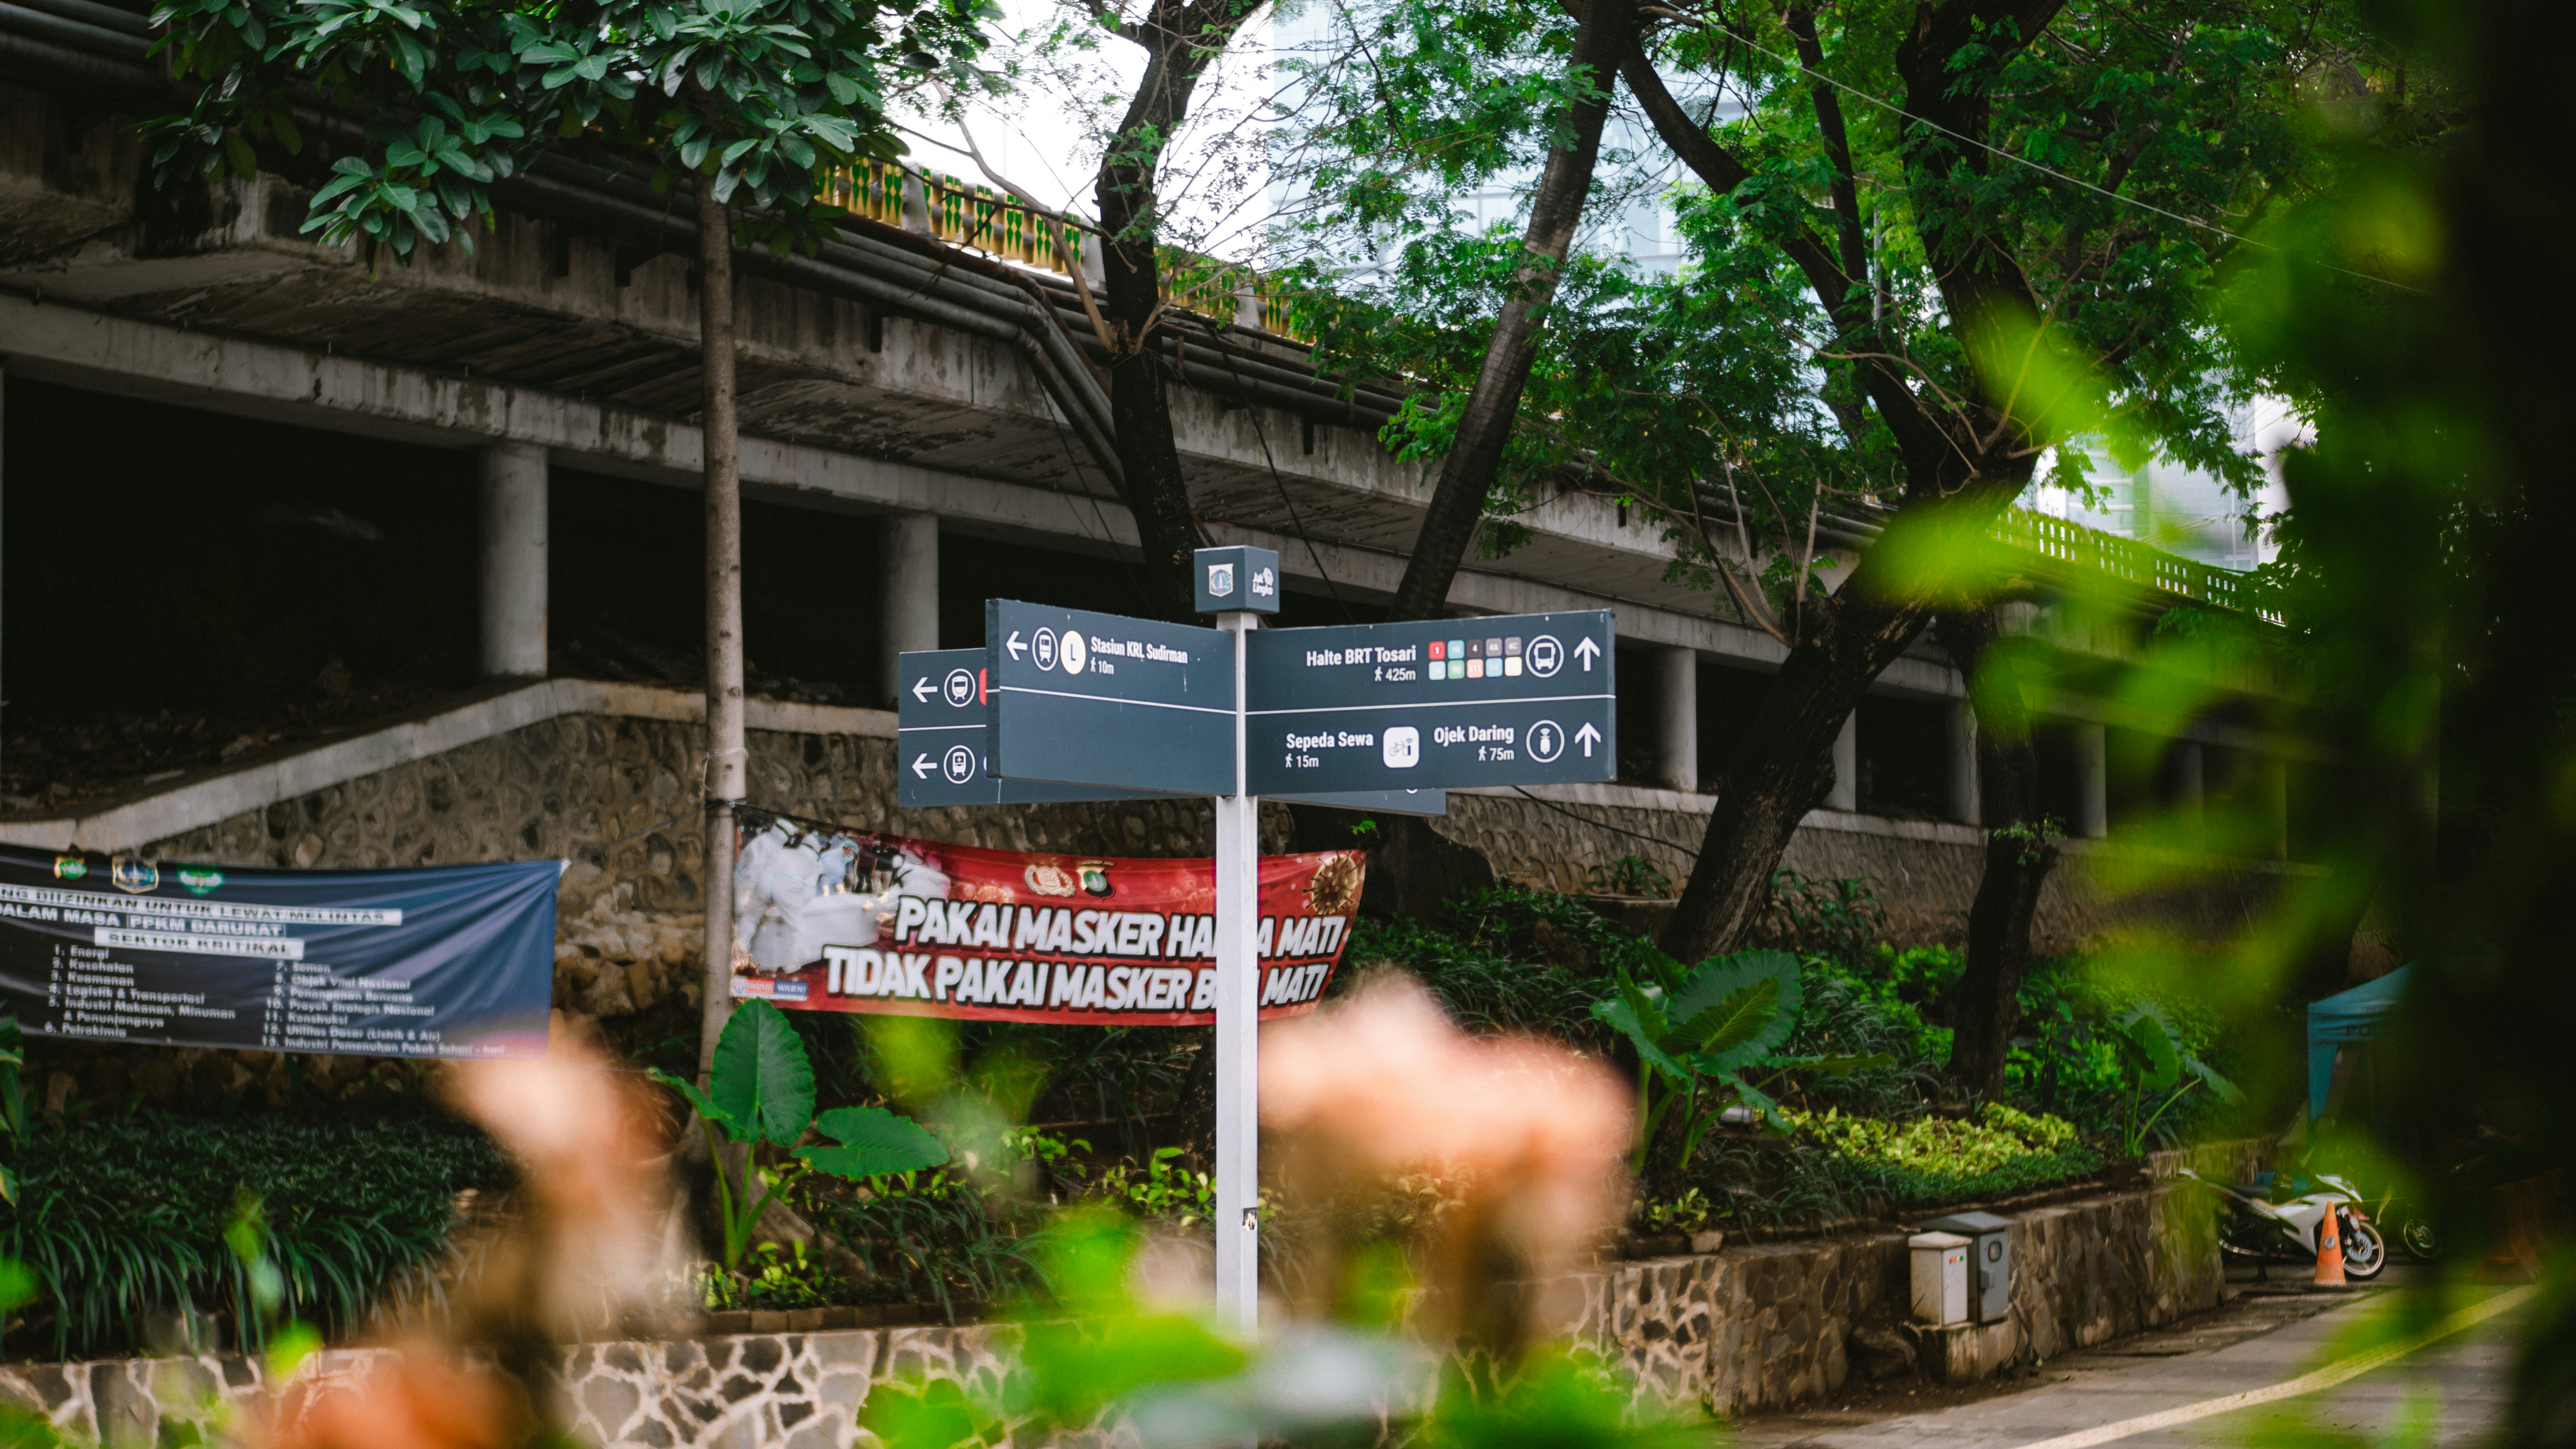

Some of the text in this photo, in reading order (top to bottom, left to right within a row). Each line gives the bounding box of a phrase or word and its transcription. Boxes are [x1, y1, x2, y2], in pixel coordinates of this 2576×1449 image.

[1071, 643, 1076, 661] L
[1091, 636, 1188, 664] Stasiun KRL Sudirman
[1306, 645, 1416, 666] Halte BRT Tosari
[1434, 646, 1440, 655] 1
[1098, 660, 1114, 674] 10m
[1385, 668, 1416, 681] 425m
[1286, 731, 1373, 752] Sepeda Sewa
[1434, 724, 1514, 747] Ojek Daring
[1296, 755, 1319, 768] 15m
[1489, 747, 1514, 761] 75m
[36, 890, 138, 908] DIIZINKAN
[146, 901, 212, 915] UNTUK
[0, 902, 282, 937] ALAM MASA PPKM DARURAT
[895, 895, 1346, 957] PAKAI MASKER HAA MATI
[109, 933, 290, 953] SEKTOR KRITIKAL
[71, 945, 109, 961] Energi
[69, 958, 134, 974] Kesehatan
[68, 971, 135, 987] Keamanan
[823, 946, 932, 999] TIDAK
[935, 955, 1049, 1006] PAKAI
[1049, 964, 1192, 1009] MASKER
[1260, 964, 1329, 1006] MATI
[67, 984, 113, 999] Logistik
[130, 988, 205, 1005] Transportasi
[746, 982, 806, 994] WARNA WARNI
[65, 997, 112, 1011] Industri
[179, 1004, 236, 1020] Minuman
[62, 1022, 127, 1037] Petrokimia
